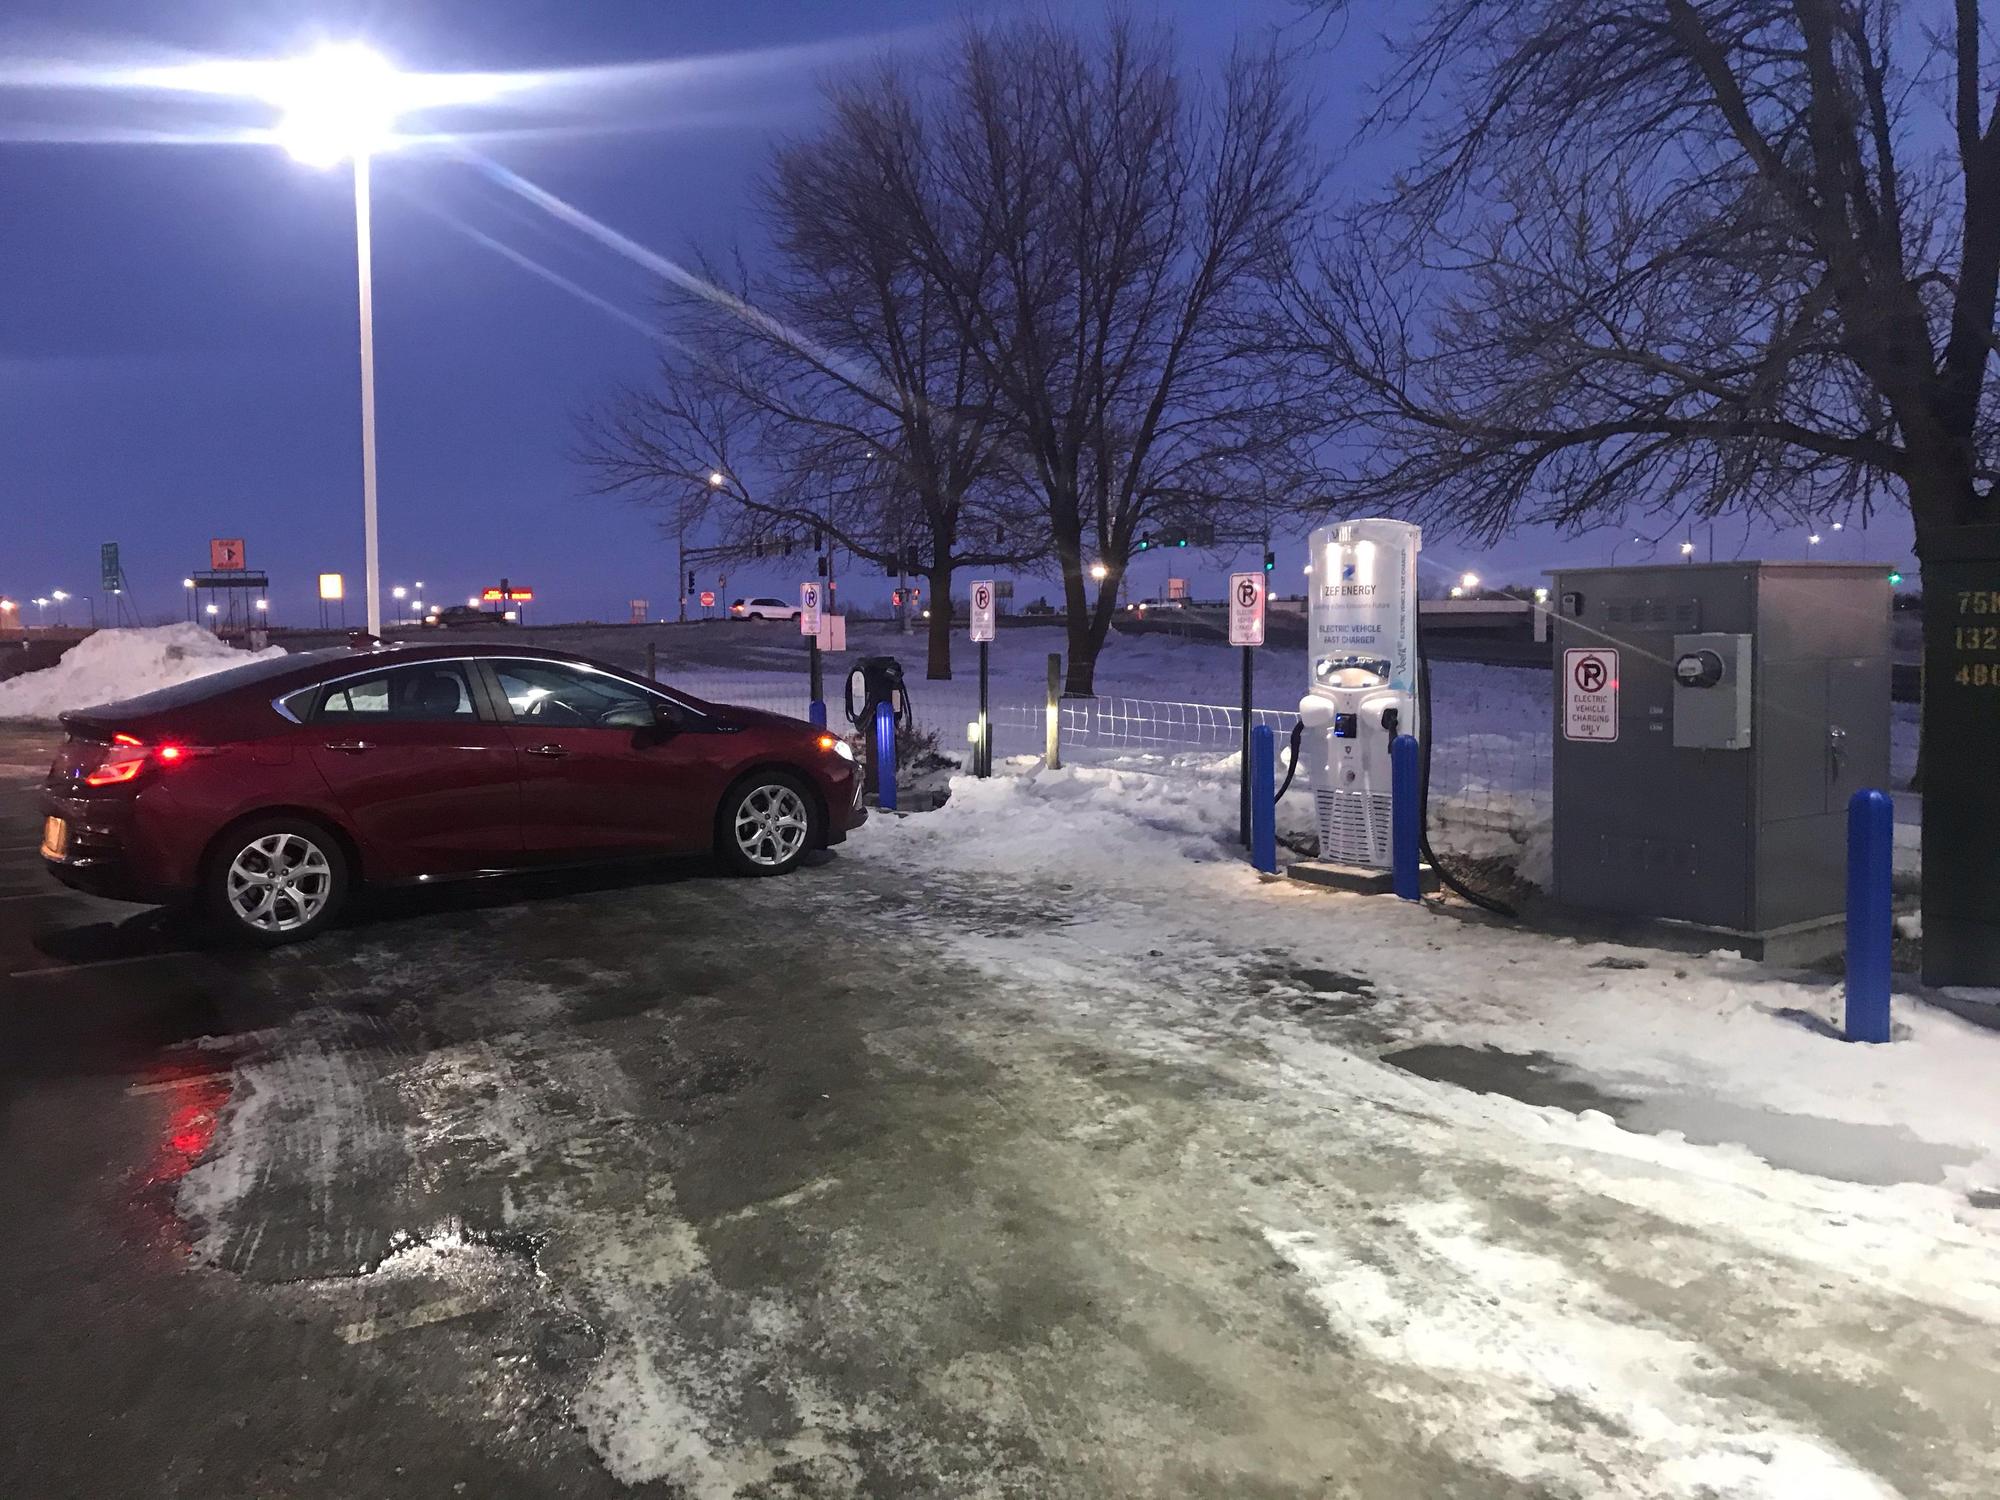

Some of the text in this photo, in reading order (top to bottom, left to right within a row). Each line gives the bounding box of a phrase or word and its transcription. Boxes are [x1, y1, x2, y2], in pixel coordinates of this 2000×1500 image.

[1325, 584, 1377, 597] ZEF ENERGY
[1319, 624, 1382, 633] ELECTRIC VEHICLE
[1324, 635, 1376, 645] FAST CHARGER
[1574, 694, 1608, 703] ELECTRIC
[1575, 705, 1606, 713] VEHICLE
[1572, 714, 1610, 723] CHARGING
[1580, 724, 1601, 732] ONLY
